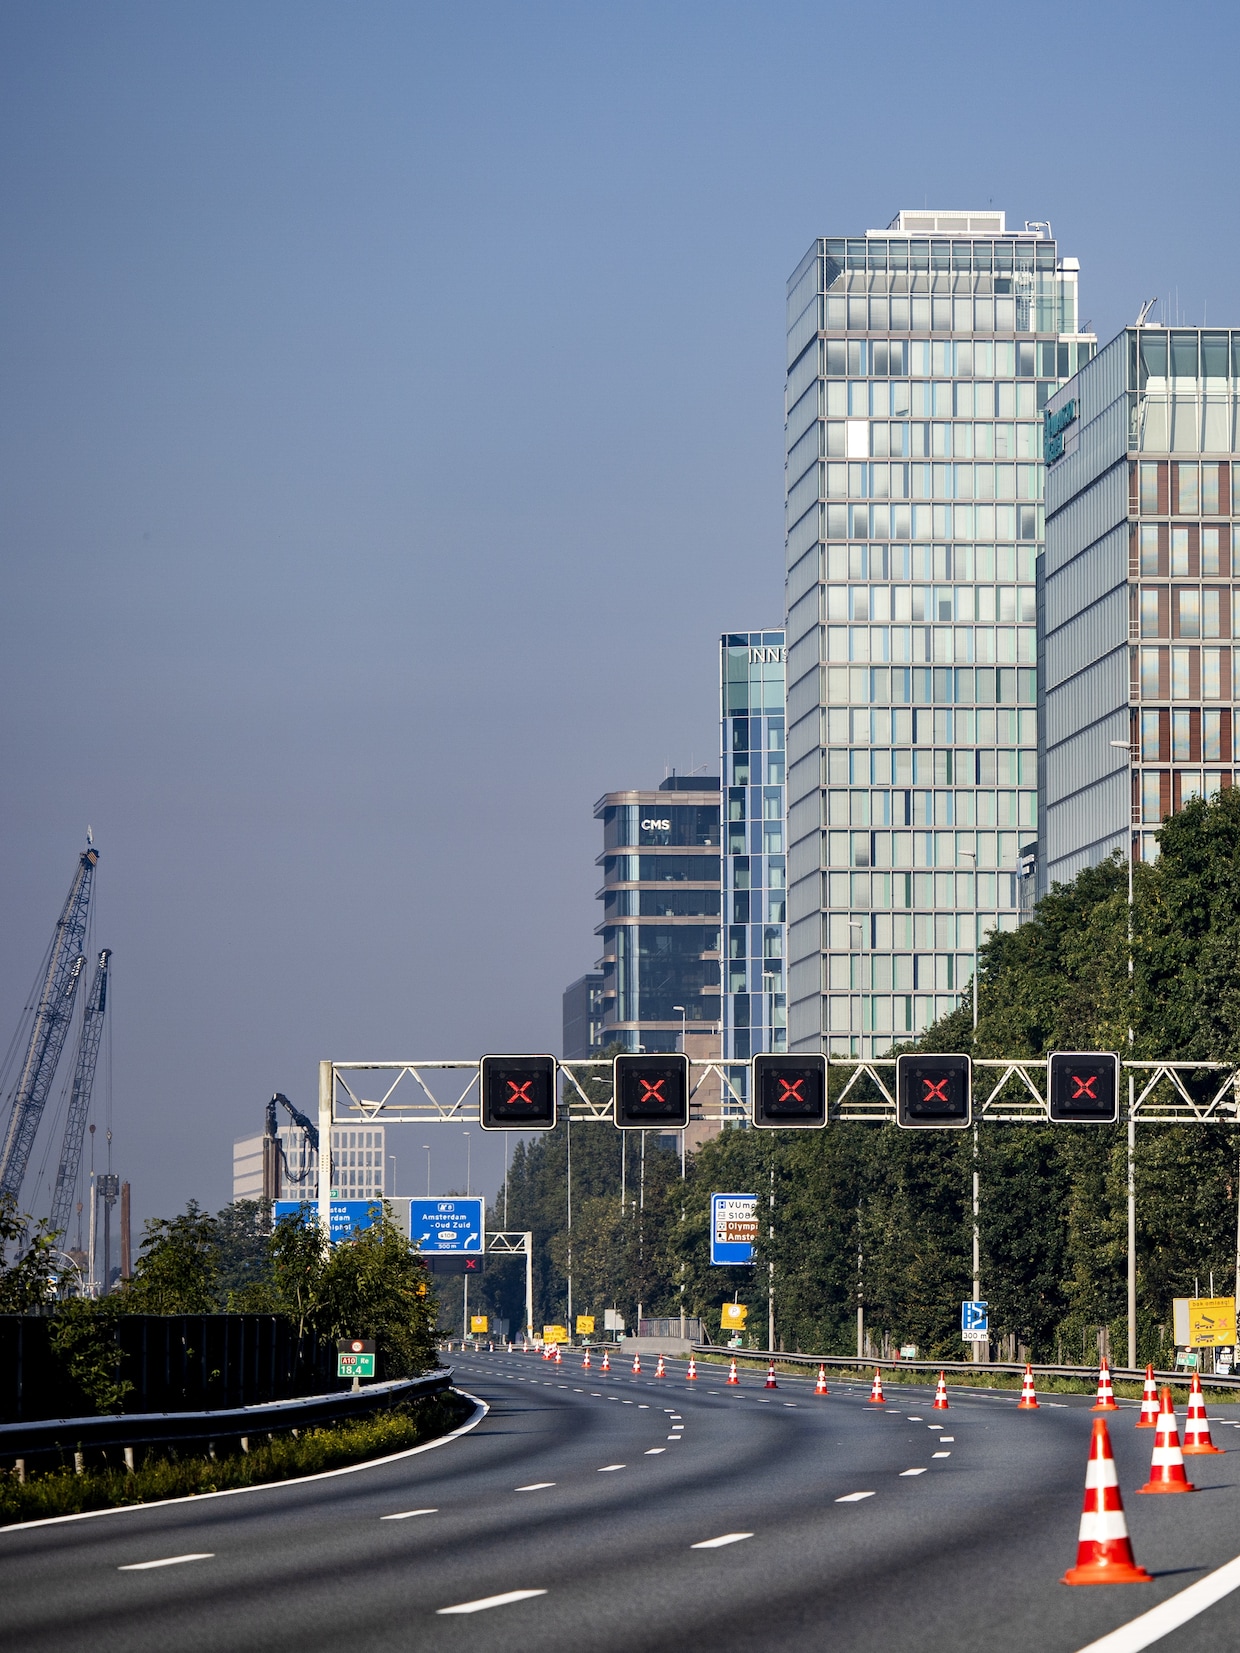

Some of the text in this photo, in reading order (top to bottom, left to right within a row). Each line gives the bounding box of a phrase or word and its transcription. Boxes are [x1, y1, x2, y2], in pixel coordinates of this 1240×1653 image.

[641, 819, 670, 830] CMS
[728, 1223, 758, 1231] Olympi
[340, 1365, 362, 1375] 18.4
